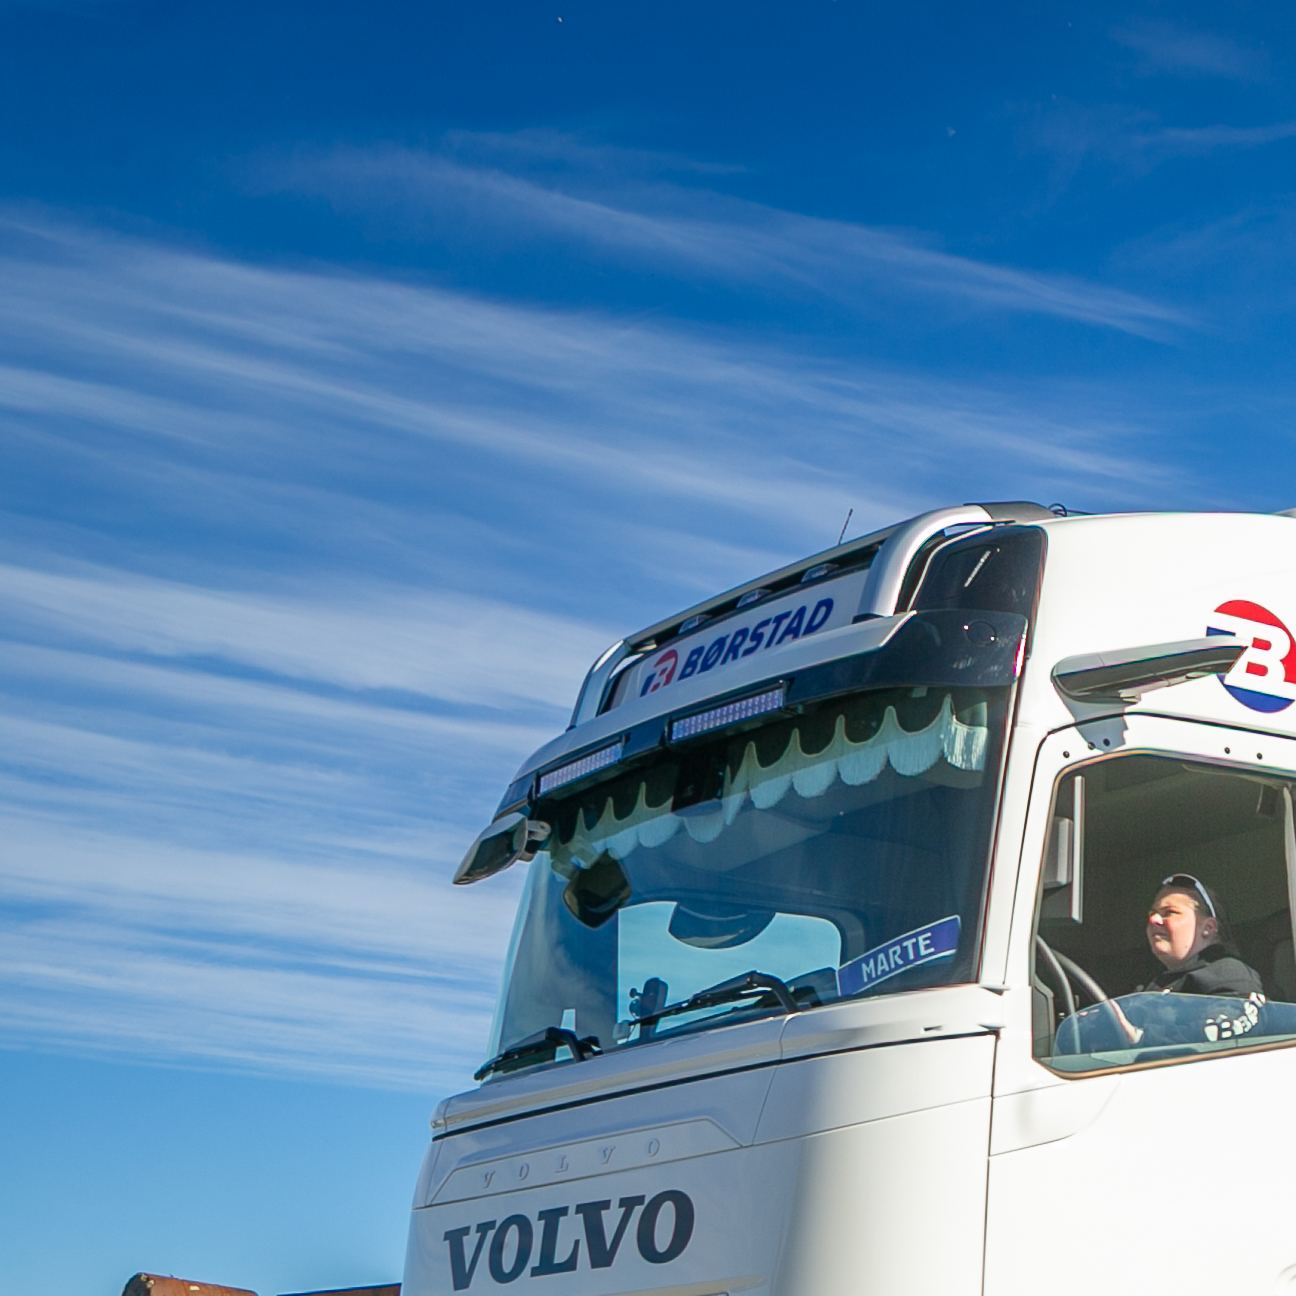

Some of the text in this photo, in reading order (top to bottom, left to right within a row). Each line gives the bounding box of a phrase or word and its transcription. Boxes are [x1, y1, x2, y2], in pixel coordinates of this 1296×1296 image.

[677, 598, 834, 681] BØRSTAD
[861, 932, 935, 983] MARTE
[482, 1137, 661, 1189] VOLVO
[443, 1189, 695, 1292] VOLVO
